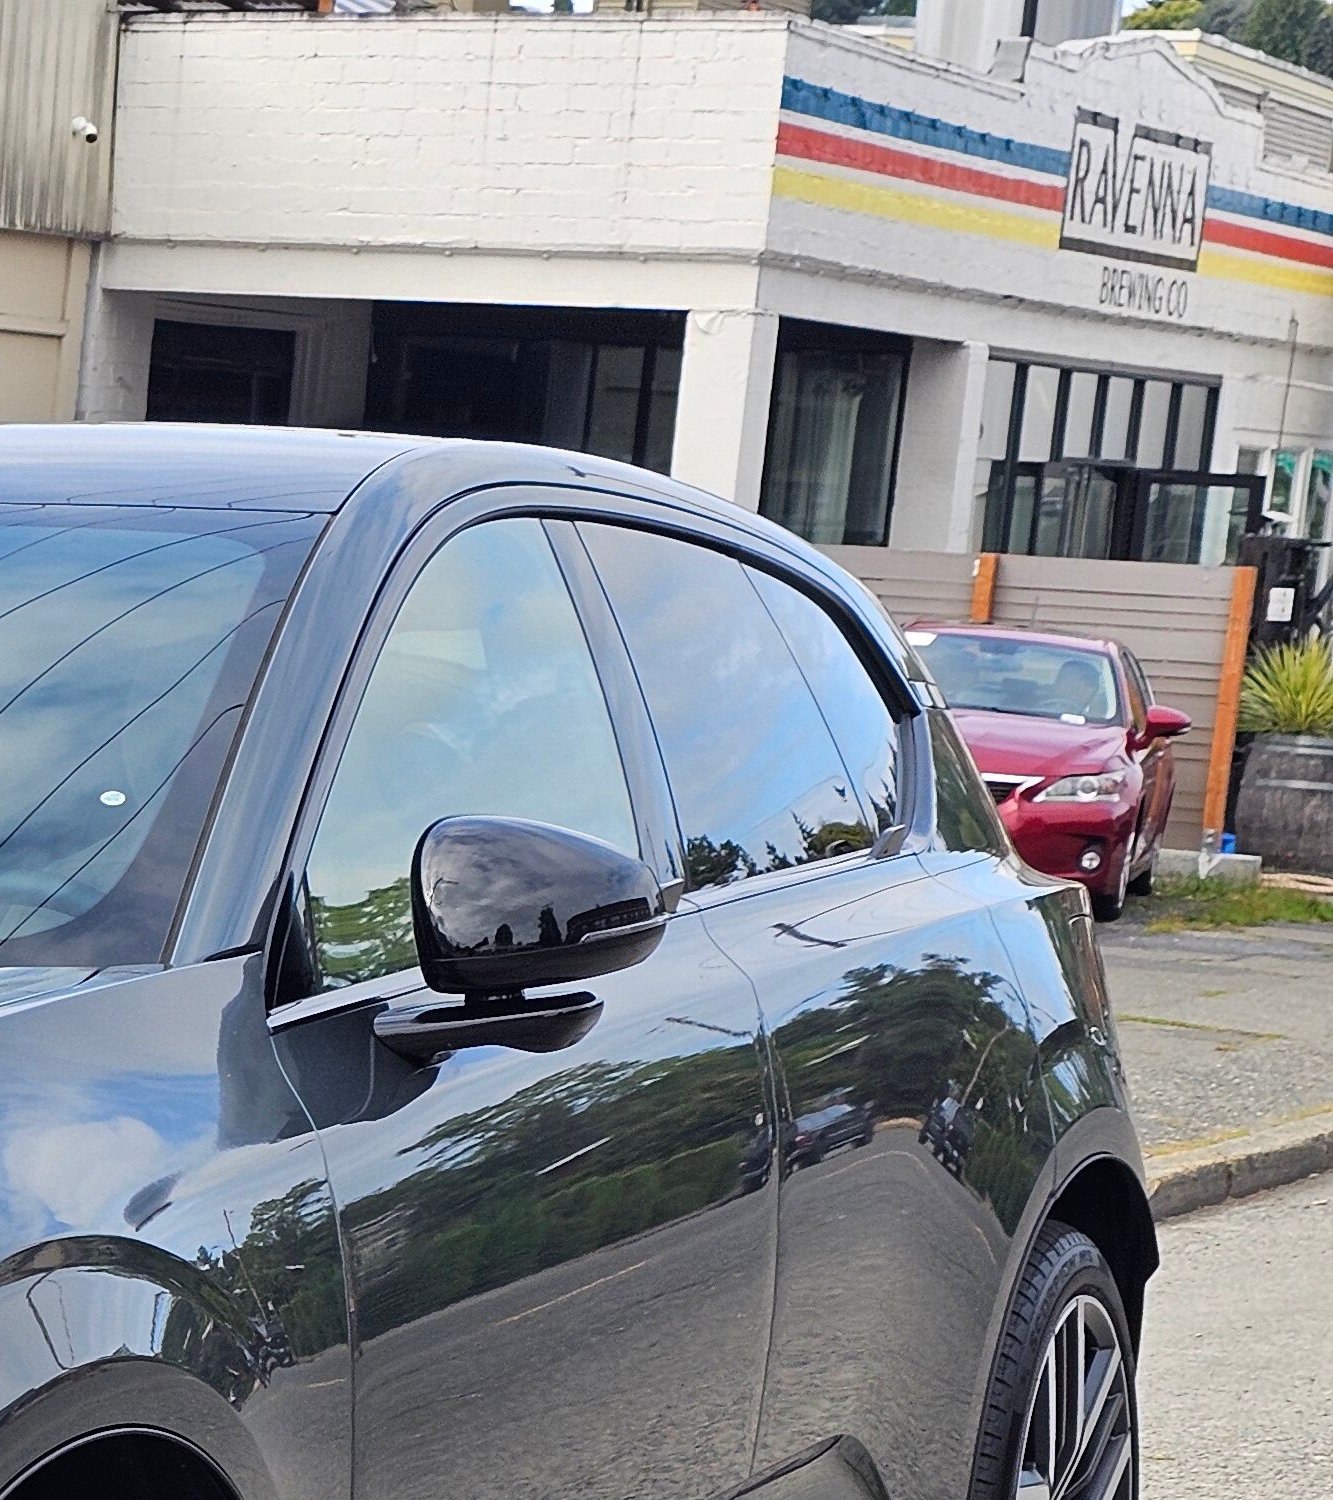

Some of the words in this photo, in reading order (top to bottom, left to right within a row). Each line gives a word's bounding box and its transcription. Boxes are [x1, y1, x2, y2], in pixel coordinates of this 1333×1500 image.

[1070, 119, 1197, 247] RAVENNA
[1099, 266, 1165, 315] BREWING
[1167, 279, 1188, 318] CO
